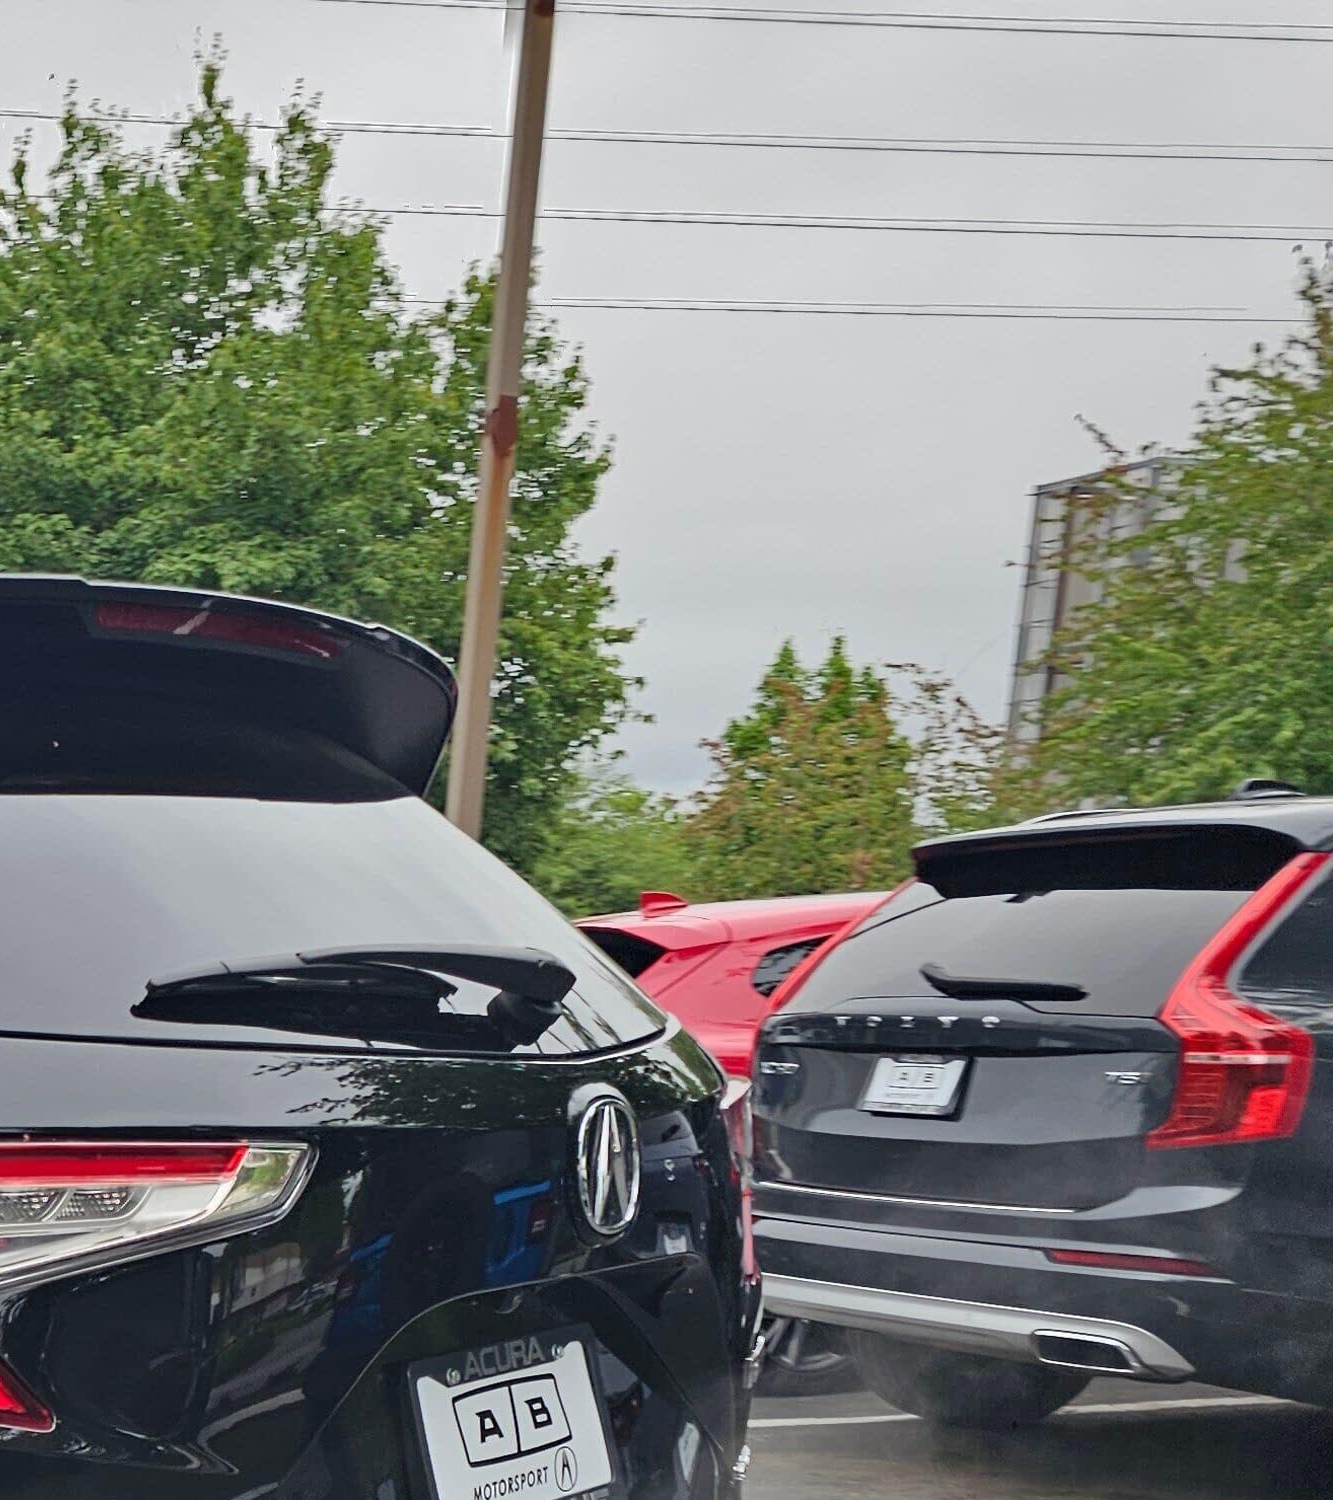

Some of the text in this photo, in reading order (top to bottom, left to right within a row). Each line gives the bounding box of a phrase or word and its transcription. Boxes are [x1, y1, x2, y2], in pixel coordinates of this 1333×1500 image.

[464, 1337, 545, 1380] ACURA
[475, 1396, 553, 1443] A B
